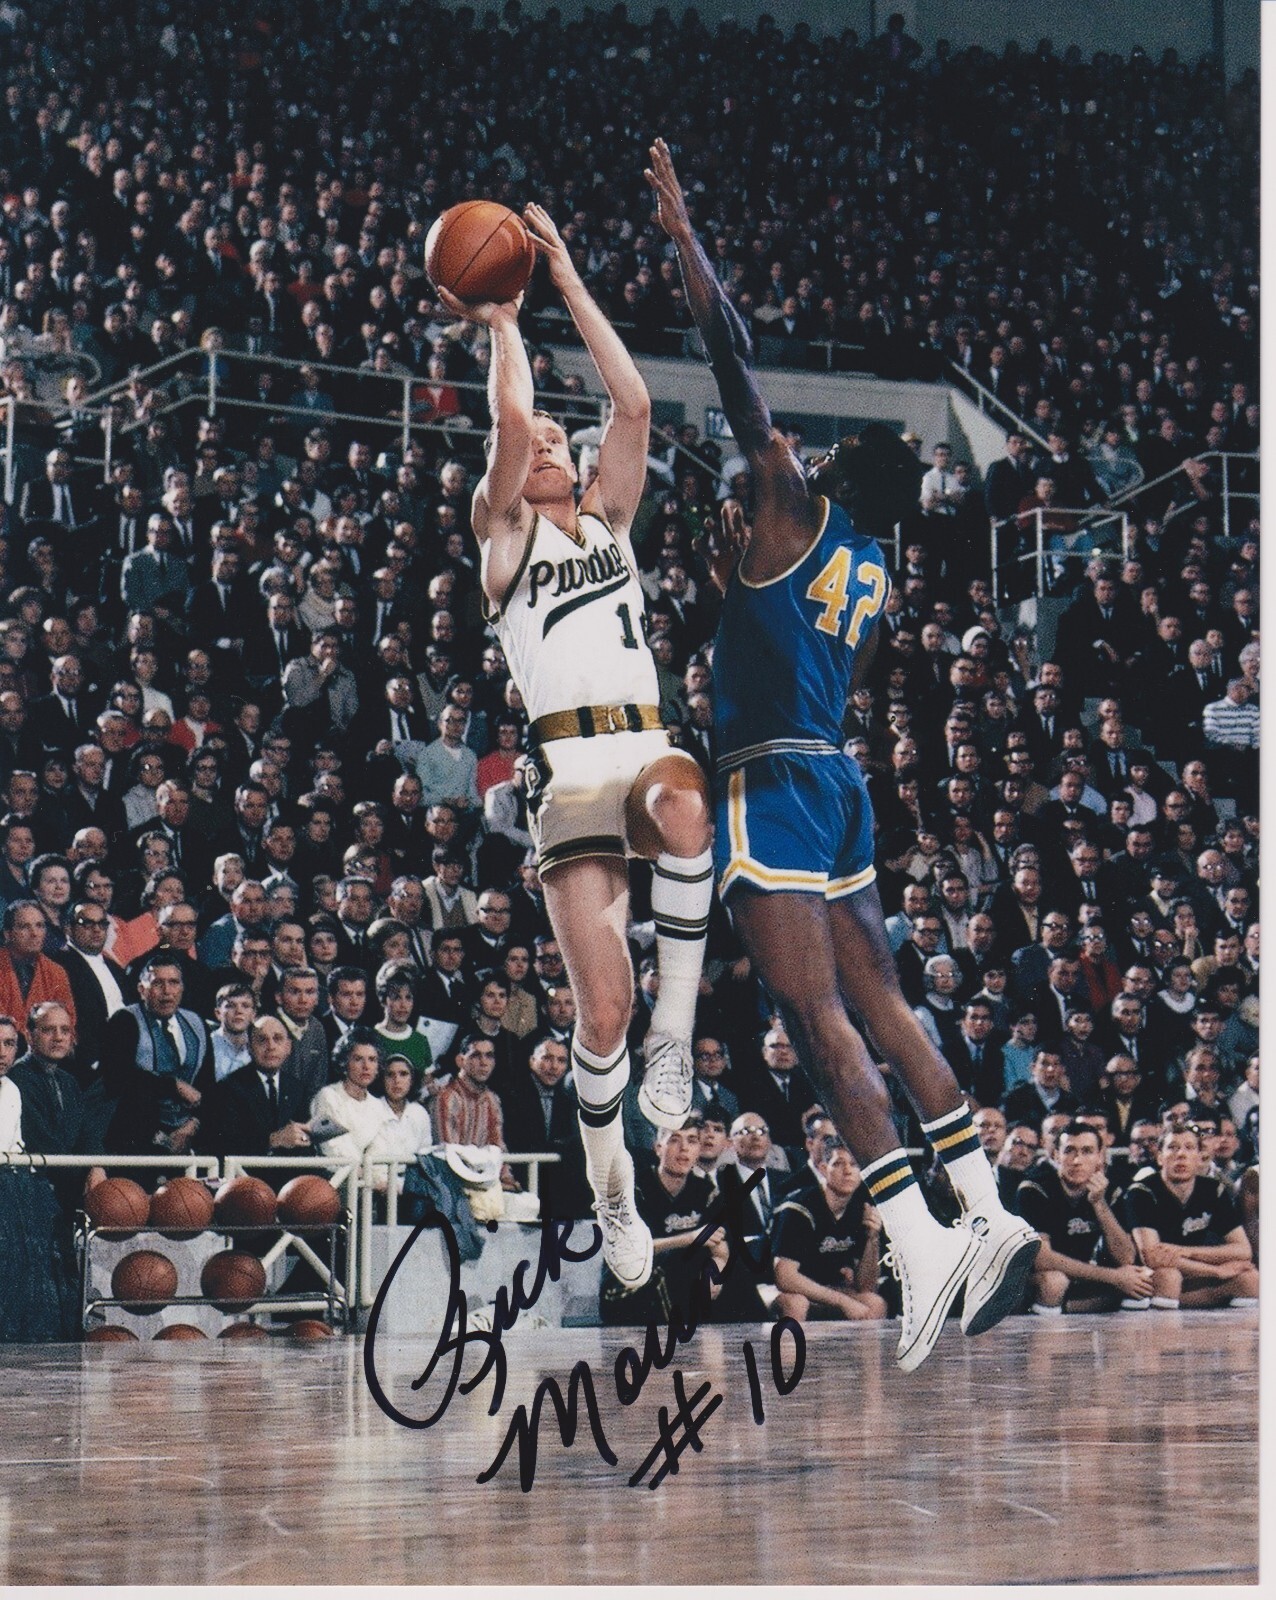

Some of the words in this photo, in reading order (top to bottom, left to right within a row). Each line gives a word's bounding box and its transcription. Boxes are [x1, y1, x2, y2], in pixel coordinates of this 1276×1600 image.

[527, 543, 628, 608] Purdue
[807, 546, 886, 649] 42
[615, 602, 647, 650] 1
[364, 1167, 602, 1430] Rick
